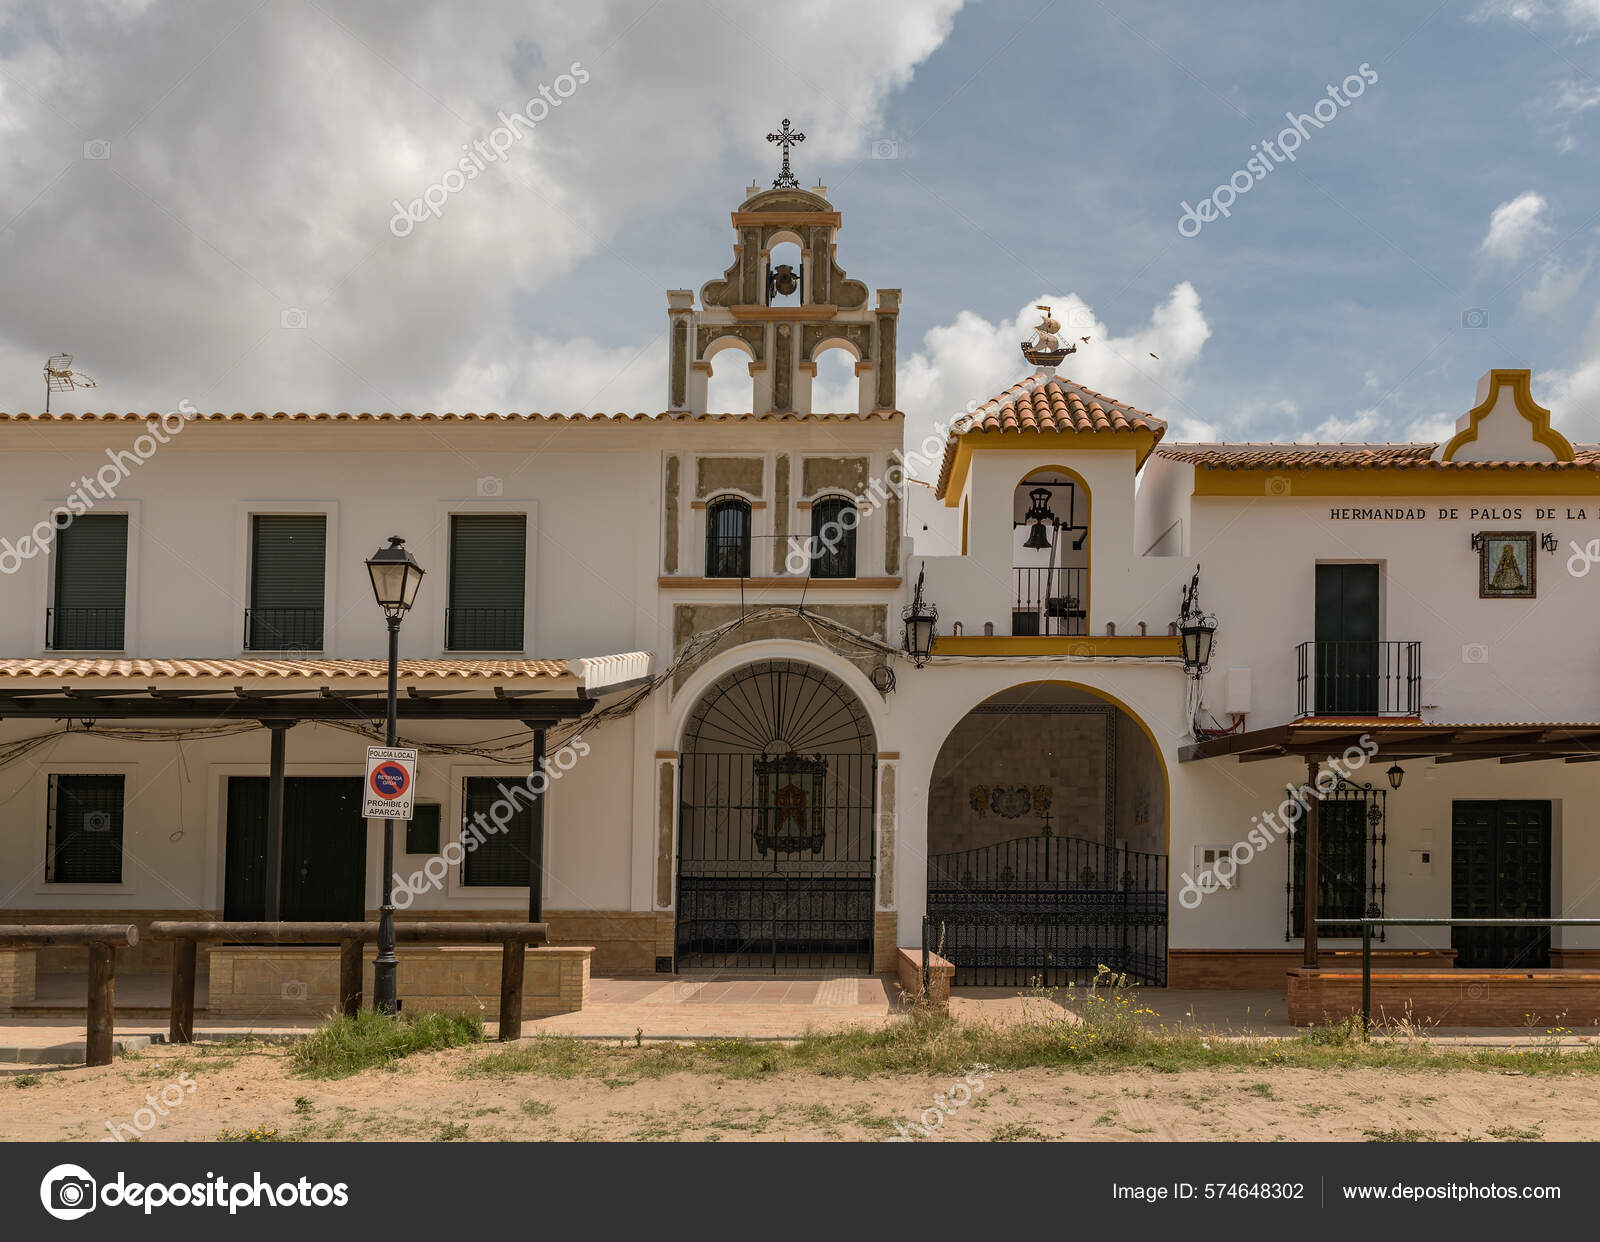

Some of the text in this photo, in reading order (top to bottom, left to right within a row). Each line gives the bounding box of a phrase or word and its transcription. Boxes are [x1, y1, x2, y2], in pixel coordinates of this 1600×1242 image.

[1330, 508, 1426, 520] HERMANDAD
[1438, 508, 1459, 520] DE
[1470, 508, 1522, 520] PALOS
[1535, 508, 1556, 520] DE
[1566, 508, 1587, 520] LA
[394, 751, 414, 759] LOCAL
